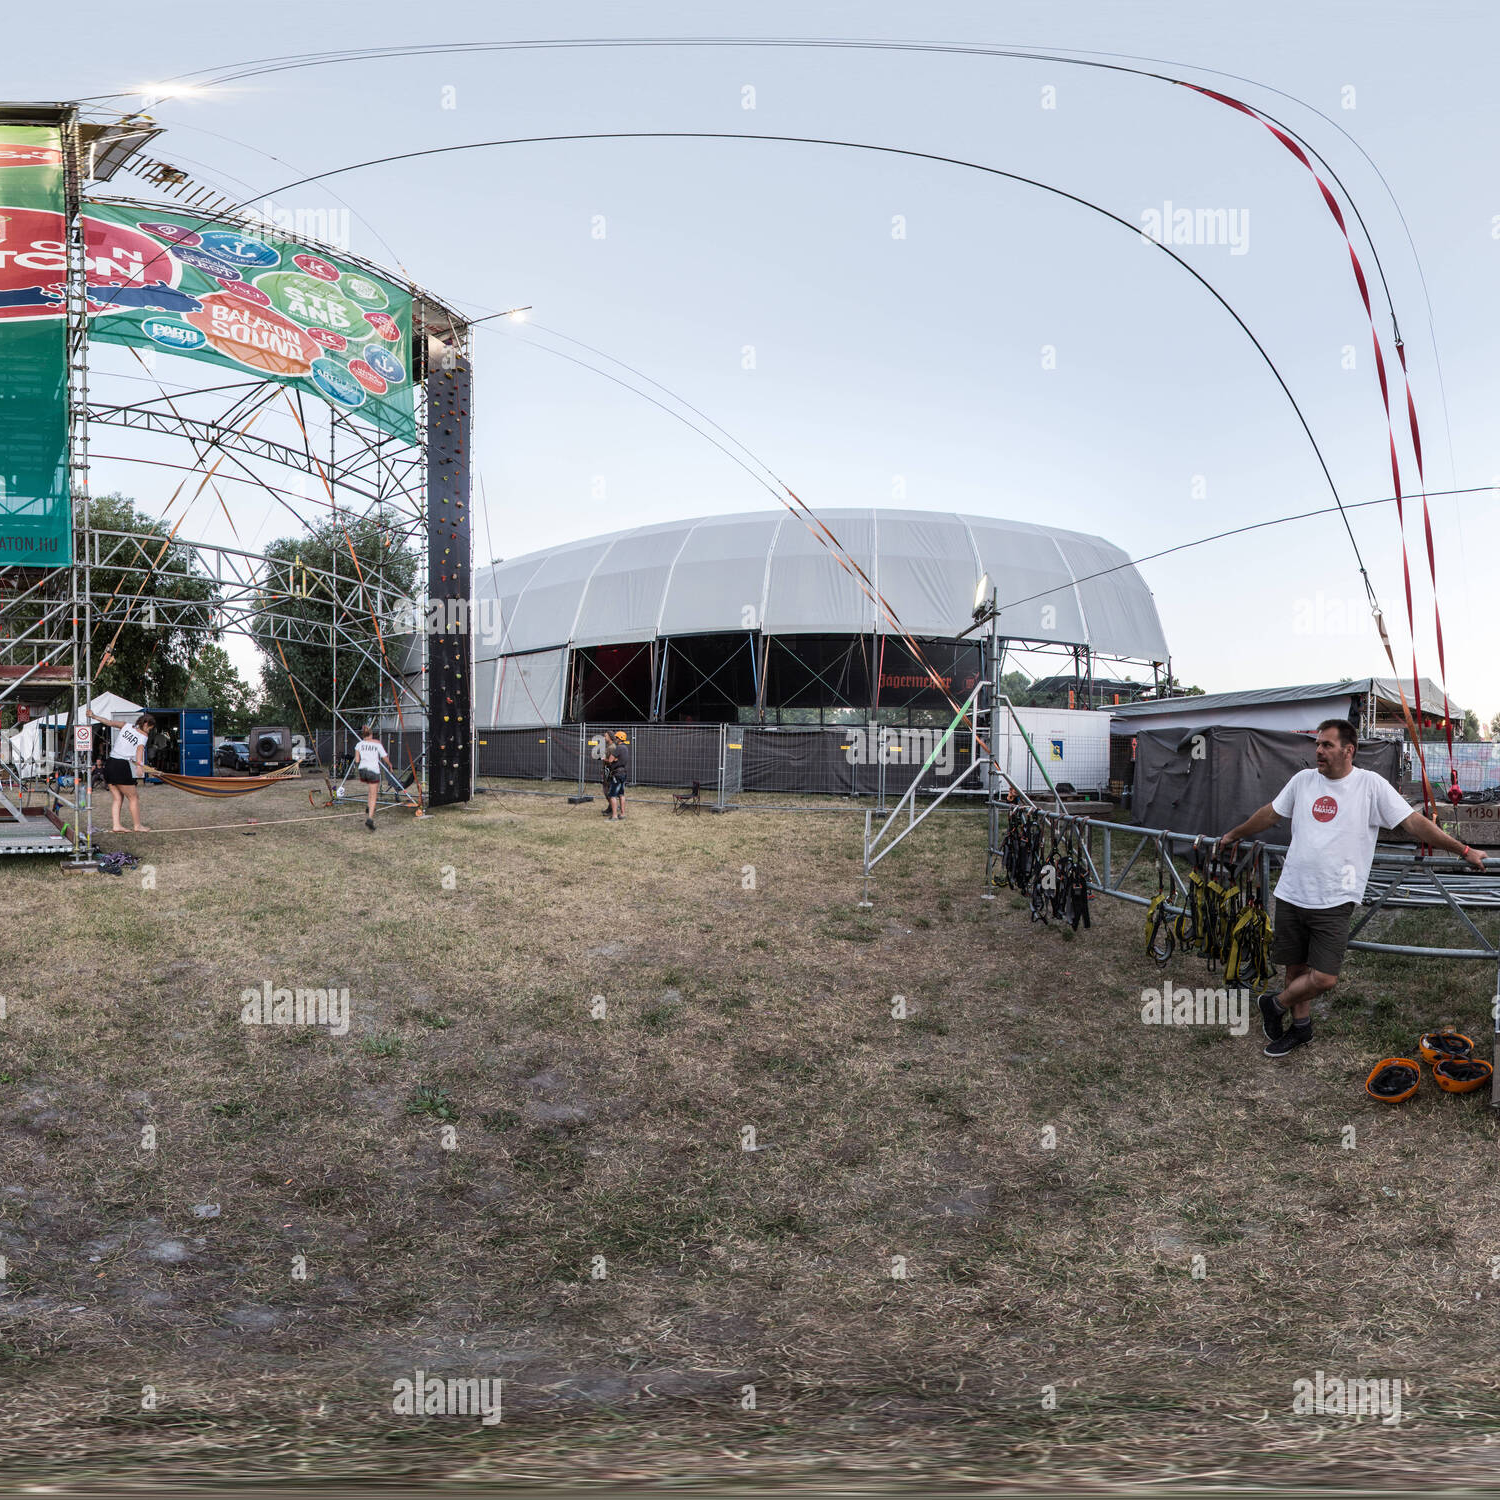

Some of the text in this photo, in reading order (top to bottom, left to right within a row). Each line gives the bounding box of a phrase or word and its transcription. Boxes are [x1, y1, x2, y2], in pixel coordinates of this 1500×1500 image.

[211, 320, 305, 360] SOUND
[212, 305, 301, 345] BALATON
[1466, 807, 1493, 818] 1130
